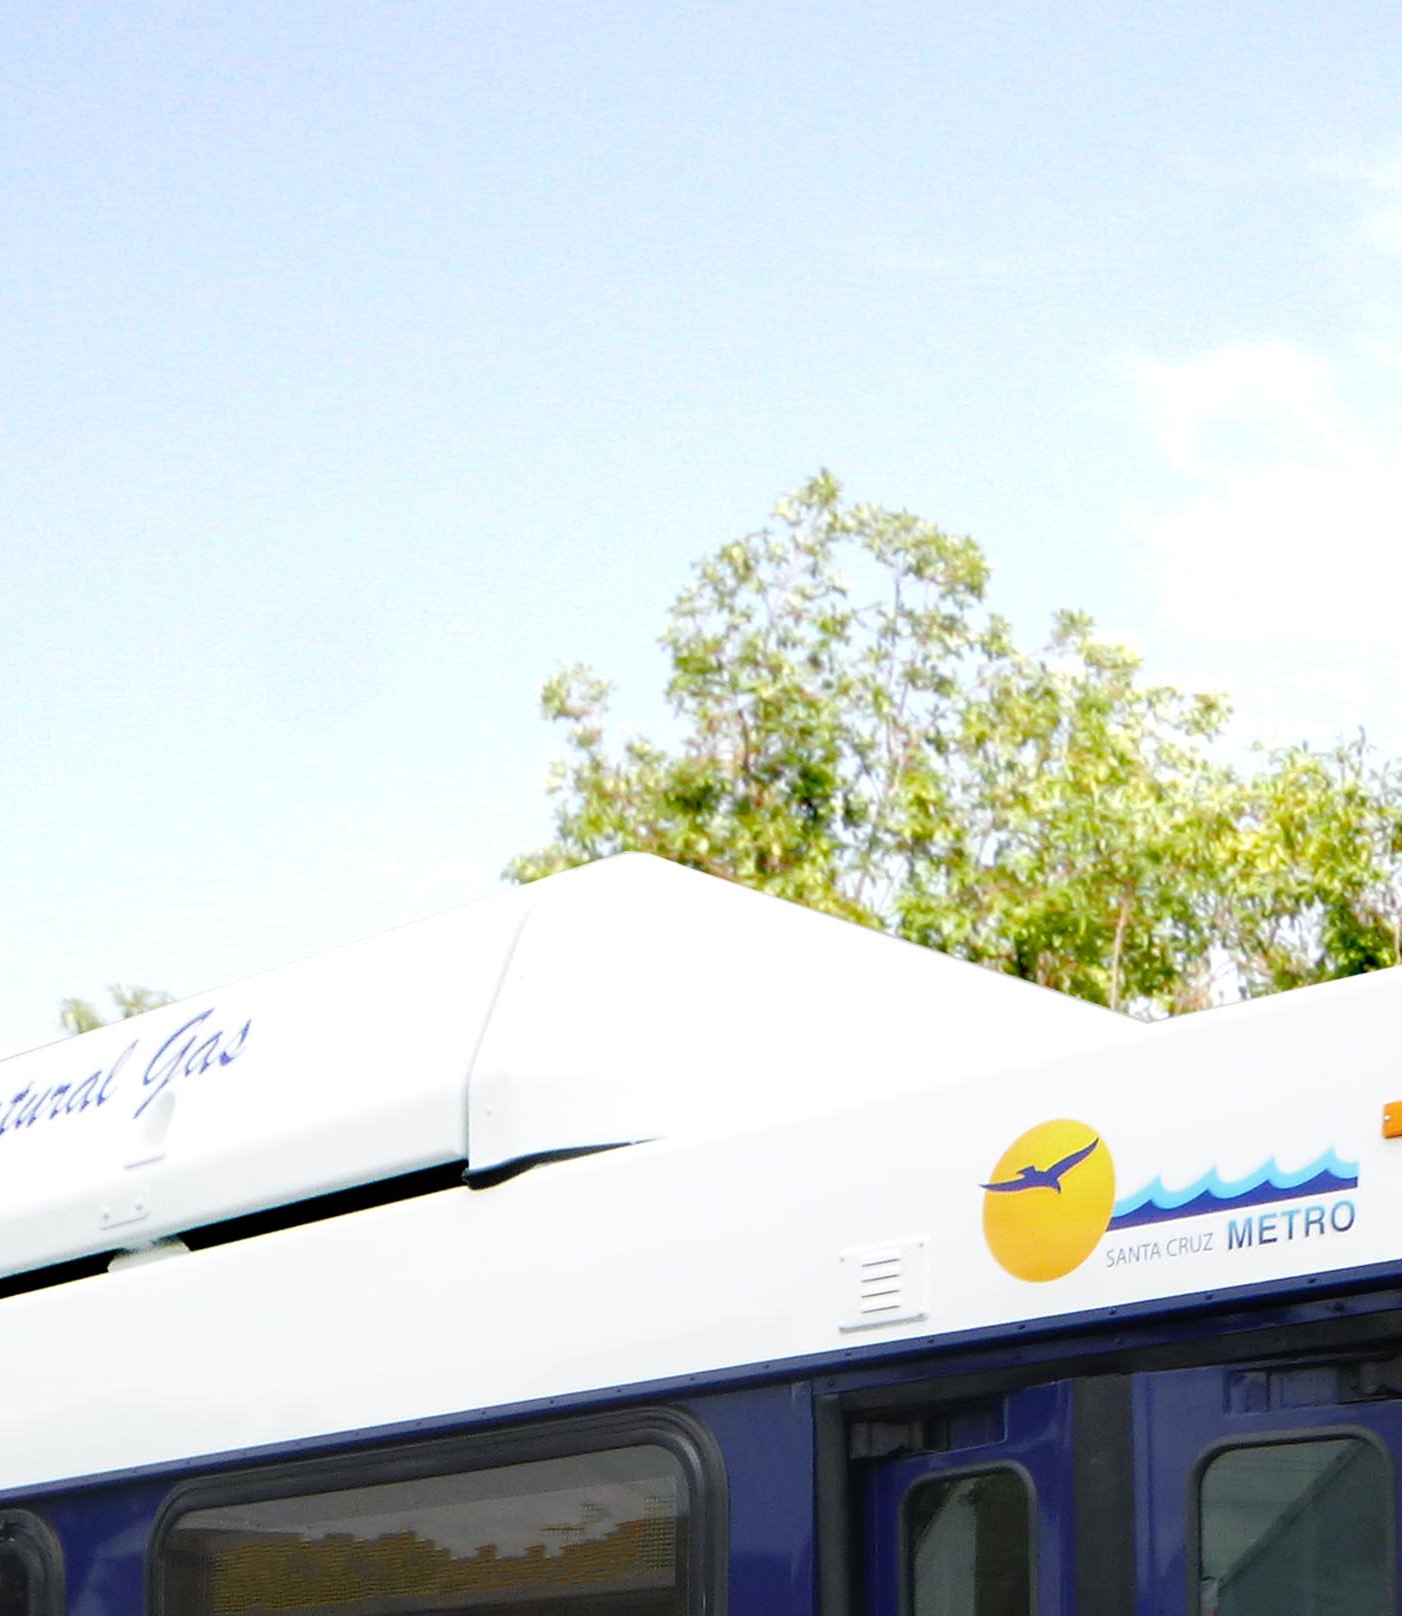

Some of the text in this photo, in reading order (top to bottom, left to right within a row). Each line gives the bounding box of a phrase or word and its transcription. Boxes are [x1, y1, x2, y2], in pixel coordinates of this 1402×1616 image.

[133, 1007, 252, 1119] Gas
[1105, 1200, 1357, 1268] SANTA CRUZ METRO
